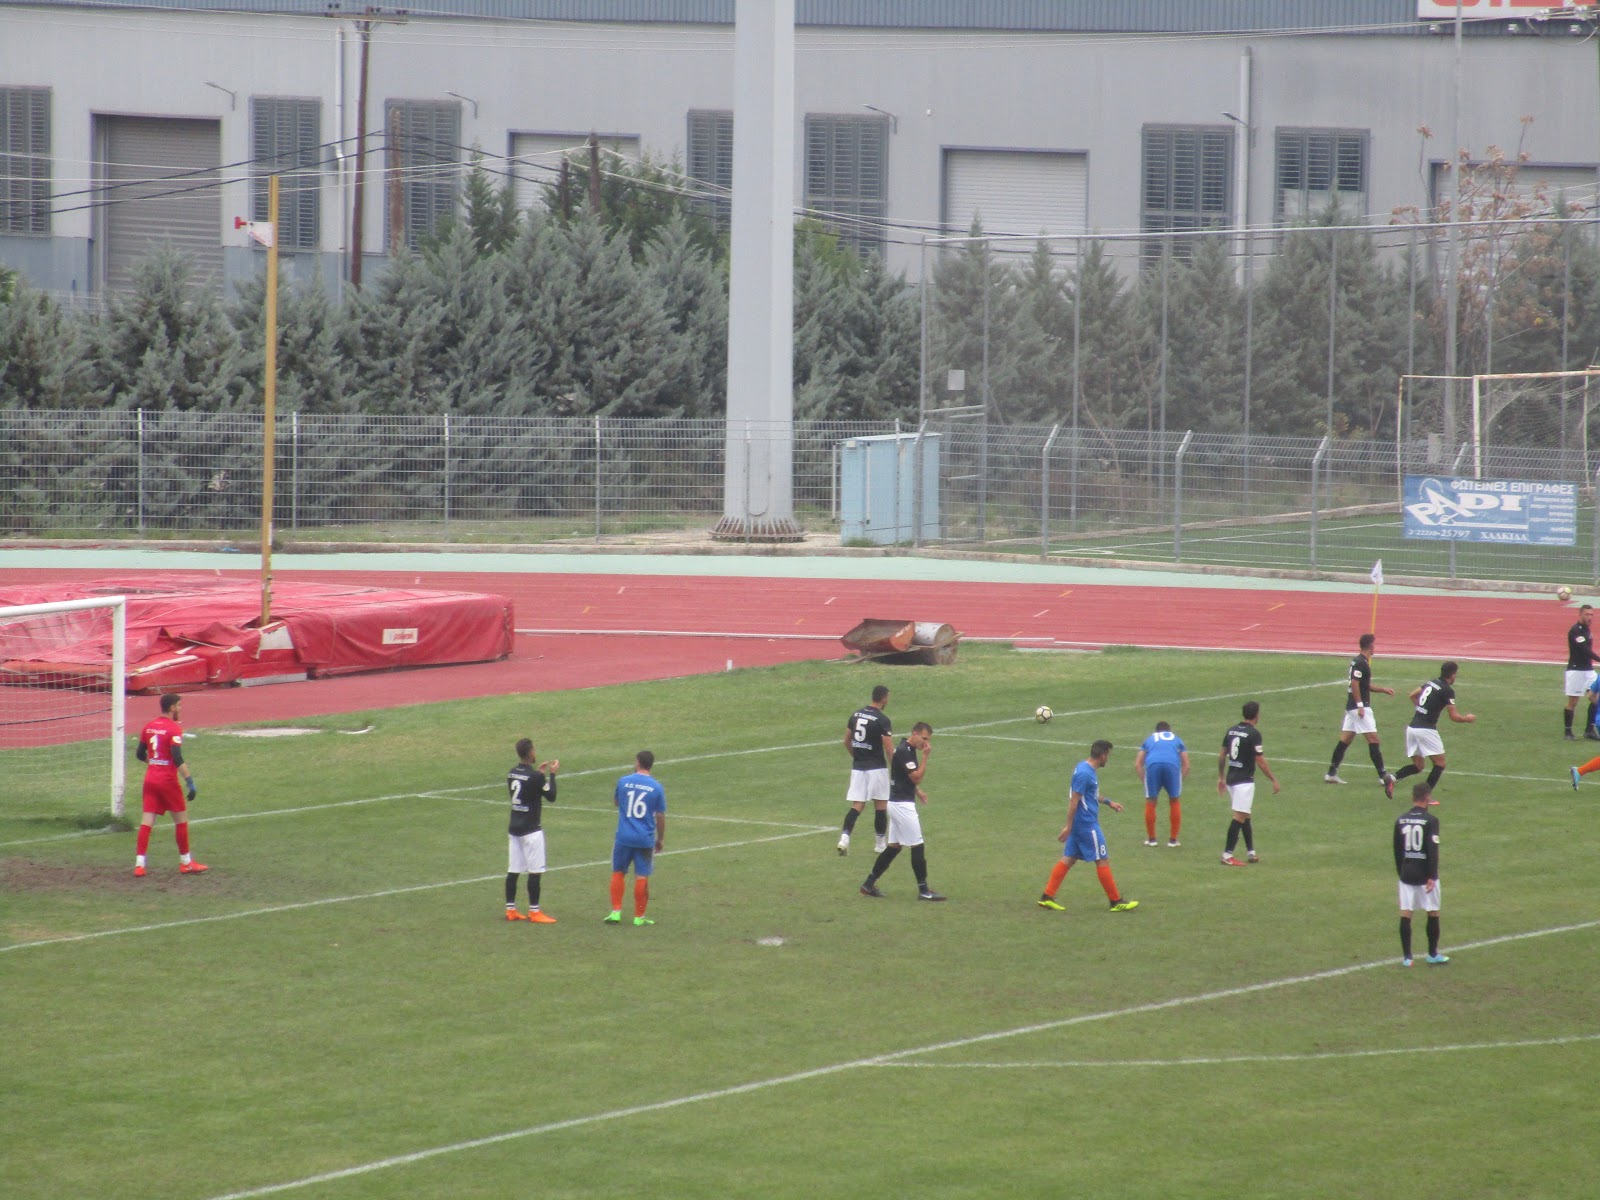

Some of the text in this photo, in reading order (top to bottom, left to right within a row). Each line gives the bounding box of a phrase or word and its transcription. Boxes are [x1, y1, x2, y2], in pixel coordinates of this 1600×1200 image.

[1450, 480, 1575, 495] ΦΩΤΕΙΝΕΣ ΕΠΙΓΡΑΦΕΣ
[1418, 685, 1433, 706] 8
[854, 718, 869, 742] 5
[1152, 731, 1176, 743] 10
[149, 734, 159, 759] 1
[1230, 736, 1241, 760] 6
[510, 779, 522, 805] 2
[626, 790, 648, 819] 16
[1099, 844, 1107, 856] 8
[1401, 824, 1424, 852] 10
